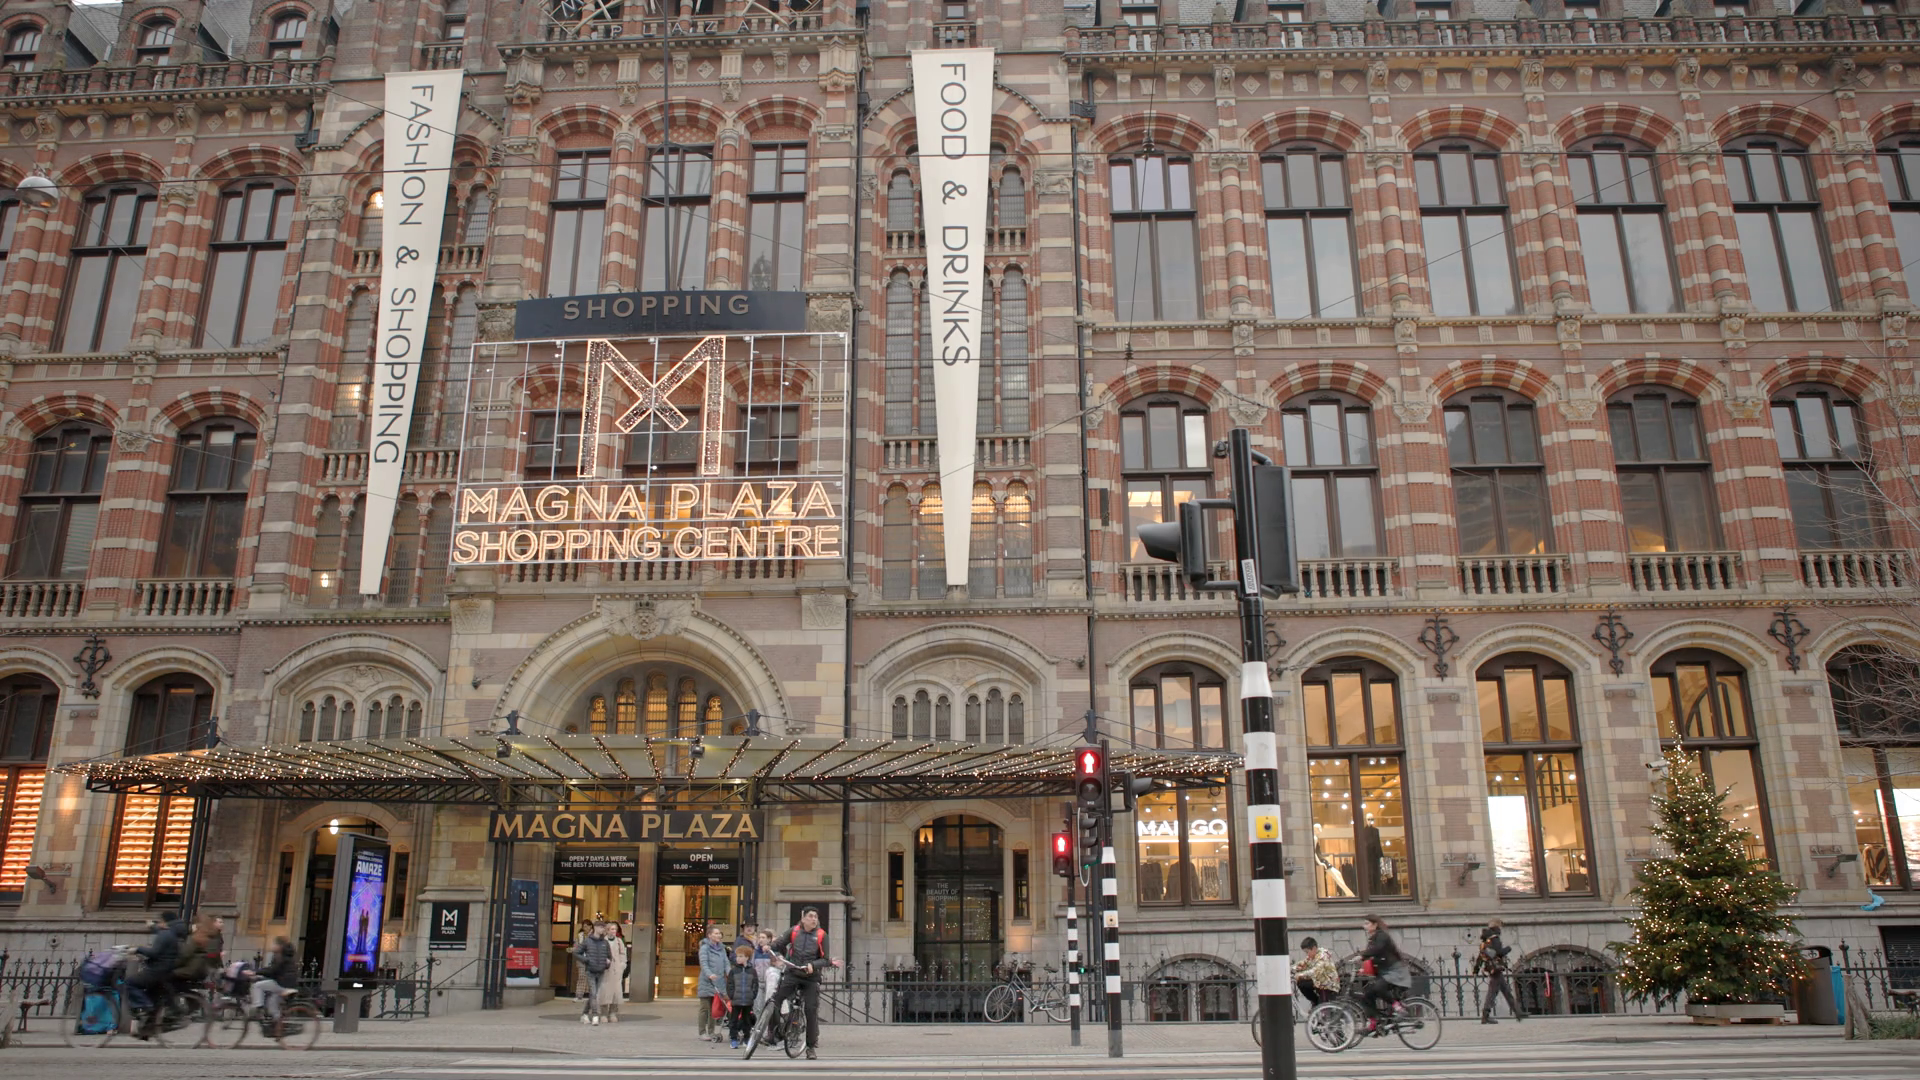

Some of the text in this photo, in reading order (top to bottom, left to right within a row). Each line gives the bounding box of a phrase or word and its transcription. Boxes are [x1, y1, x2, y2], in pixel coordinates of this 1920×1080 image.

[940, 63, 971, 366] FOOD & DRINKS
[373, 85, 434, 464] FASHION & SHOPPING
[563, 295, 750, 321] SHOPPING
[460, 480, 836, 524] MAGNA PLAZA
[453, 524, 841, 563] SHOPPING CENTRE
[493, 812, 759, 839] MAGNA PLAZA
[355, 860, 383, 876] AMAZE
[690, 853, 714, 862] OPEN
